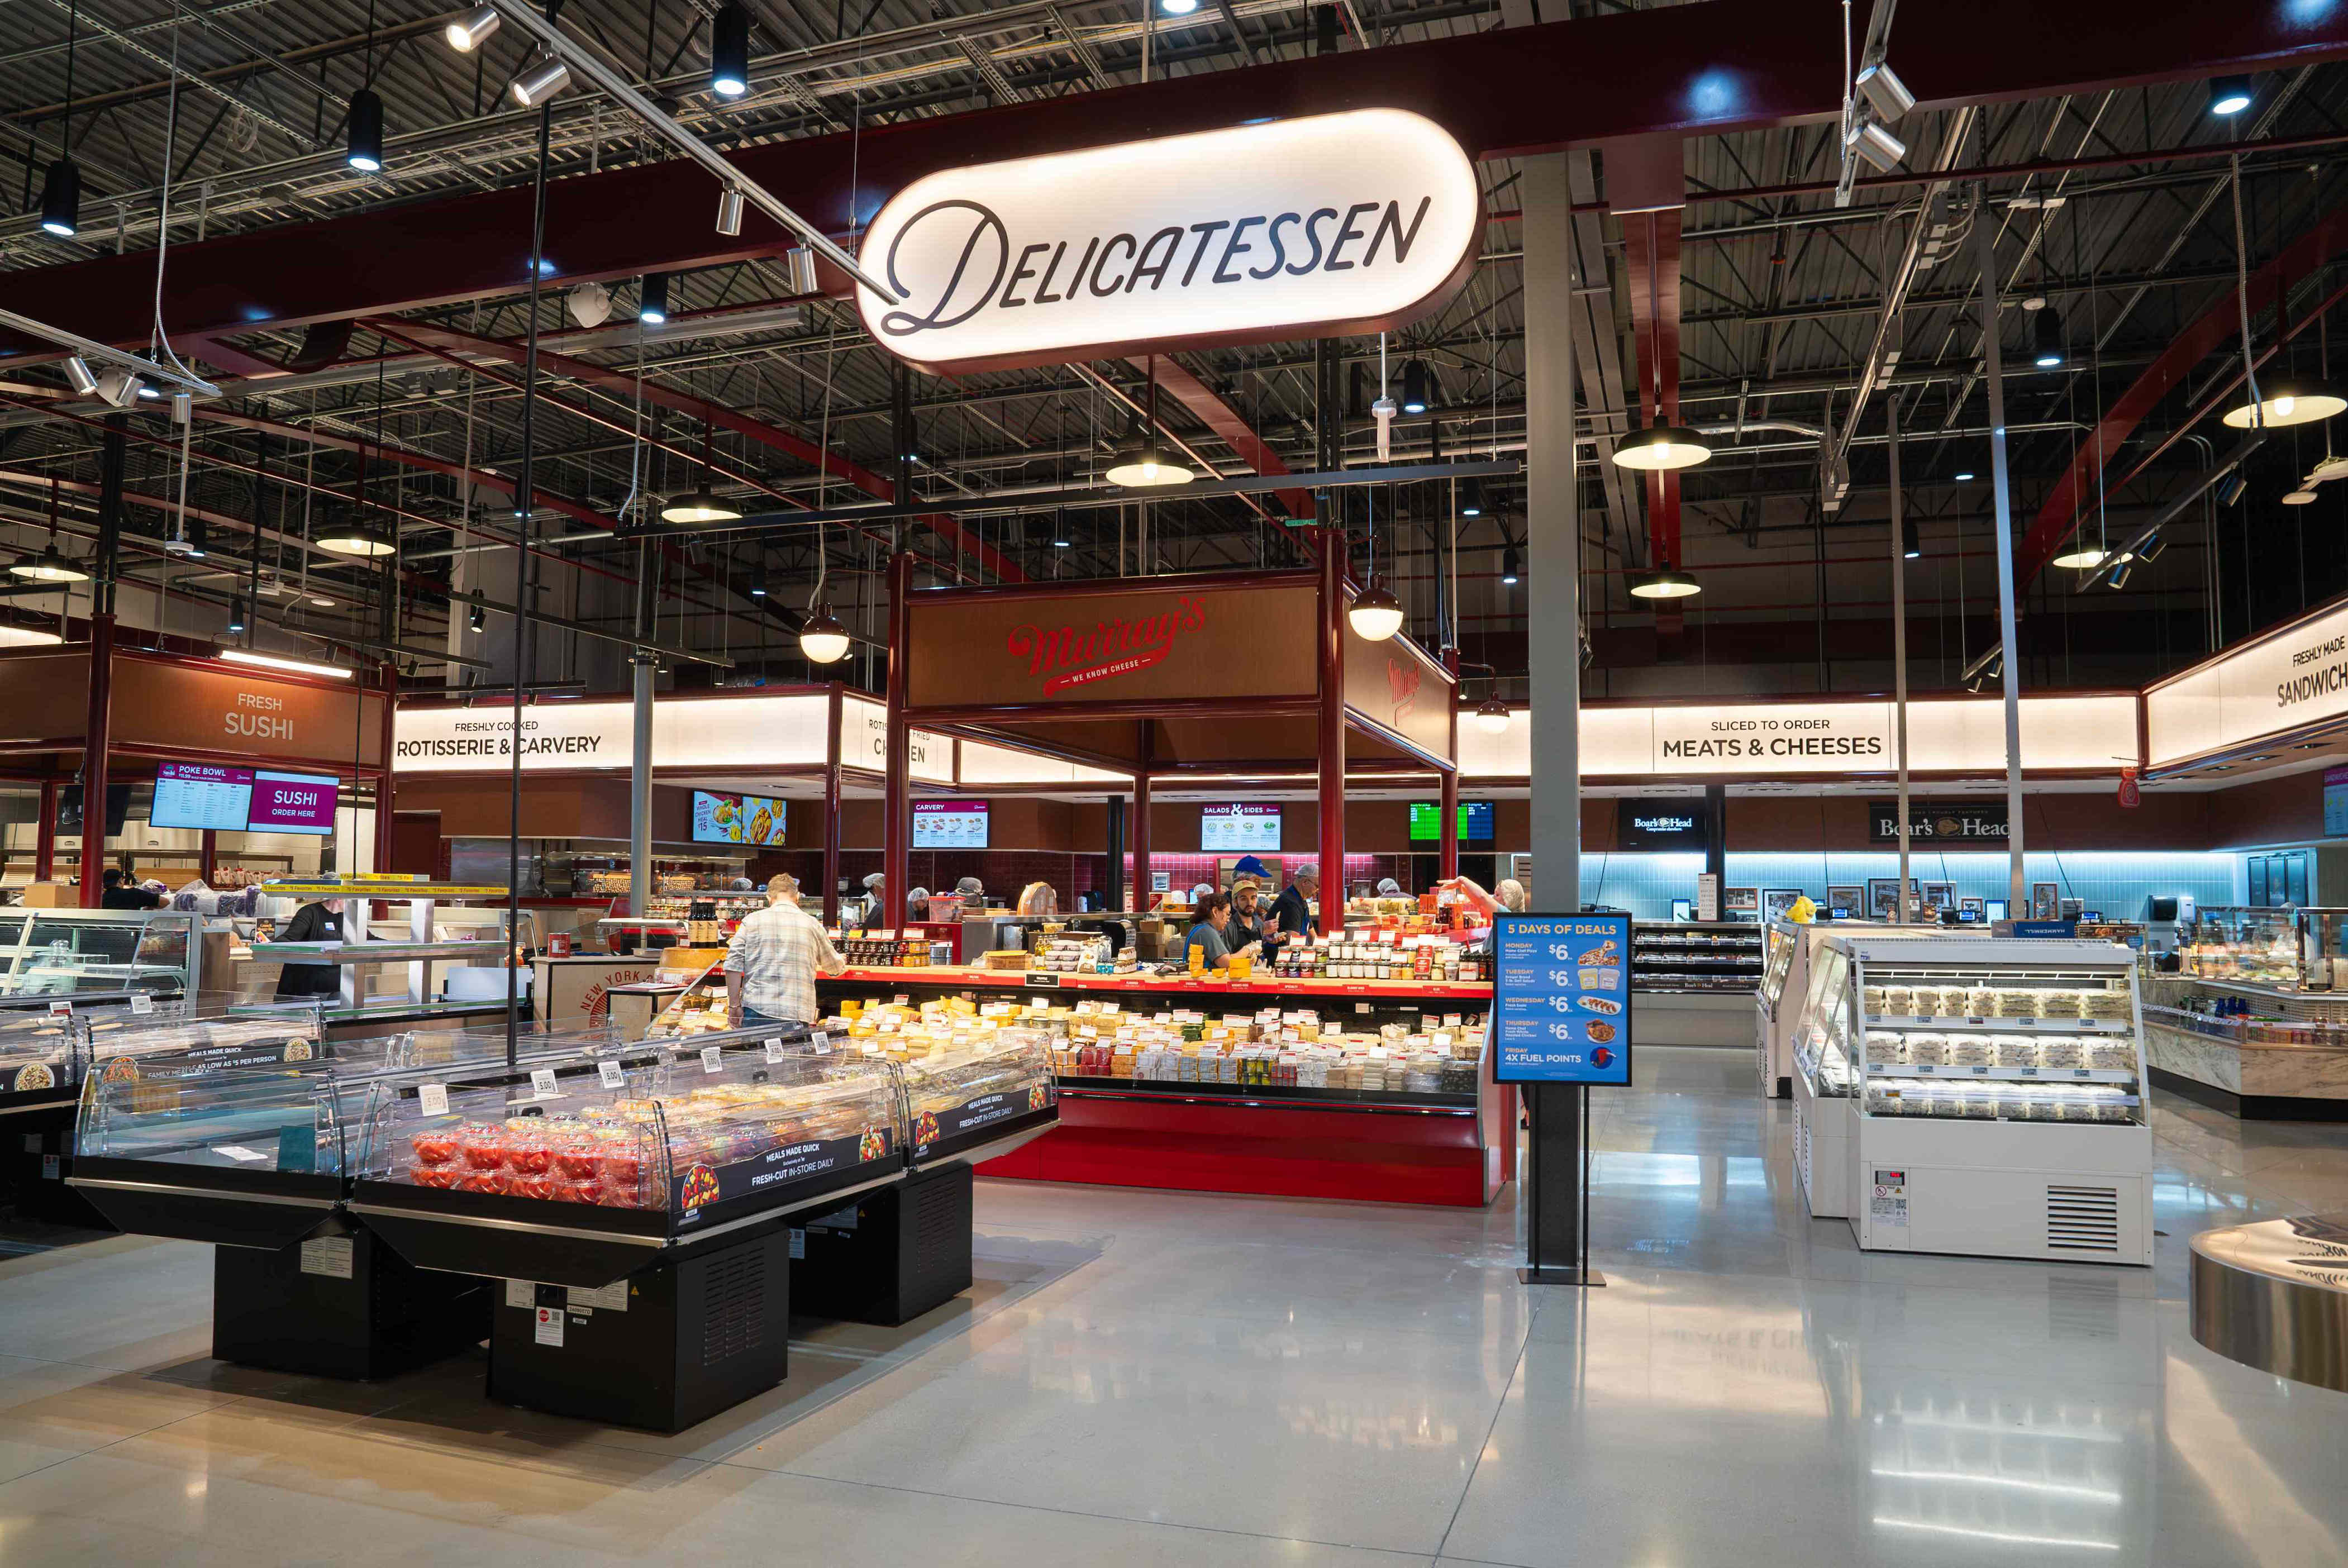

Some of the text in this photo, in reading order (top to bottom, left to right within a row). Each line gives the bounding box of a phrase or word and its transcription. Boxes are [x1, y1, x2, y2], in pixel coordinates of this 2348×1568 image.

[880, 196, 1432, 336] DELICATESSEN
[1008, 595, 1207, 678] Murray's
[2293, 635, 2345, 668] FRESHLY MADE
[1072, 659, 1139, 683] WE KNOW CHEESE
[238, 693, 282, 711] FRESH
[225, 712, 293, 740] SUSHI
[455, 722, 496, 732] FRESHLY
[1711, 719, 1830, 731] SLICED TO ORDER
[397, 736, 601, 757] ROTISSERIE & CARVERY
[1663, 737, 1882, 757] MEATS & CHEESES
[179, 766, 201, 775] POKE
[203, 768, 226, 776] BOWL
[274, 790, 317, 806] SUSHI
[272, 808, 296, 817] ORDER
[1231, 804, 1244, 816] &
[1635, 818, 1692, 827] Boar's Head
[1962, 818, 2010, 836] Head
[1508, 924, 1616, 935] 5 DAYS OF DEALS
[1549, 943, 1568, 960] $6
[1549, 970, 1568, 986] $6
[580, 971, 640, 1011] NEW YORK
[1549, 996, 1568, 1012] $6
[1549, 1023, 1568, 1040] $6
[253, 1055, 277, 1064] PERSON
[1546, 1055, 1582, 1063] POINTS
[968, 1100, 981, 1110] MEALS
[981, 1097, 991, 1105] MADE
[960, 1107, 1012, 1128] FRESH-CUT IN-STORE DAILY
[766, 1143, 820, 1163] MEALS MADE QUICK
[752, 1157, 834, 1186] FRESH-CUT IN-STORE DAILY
